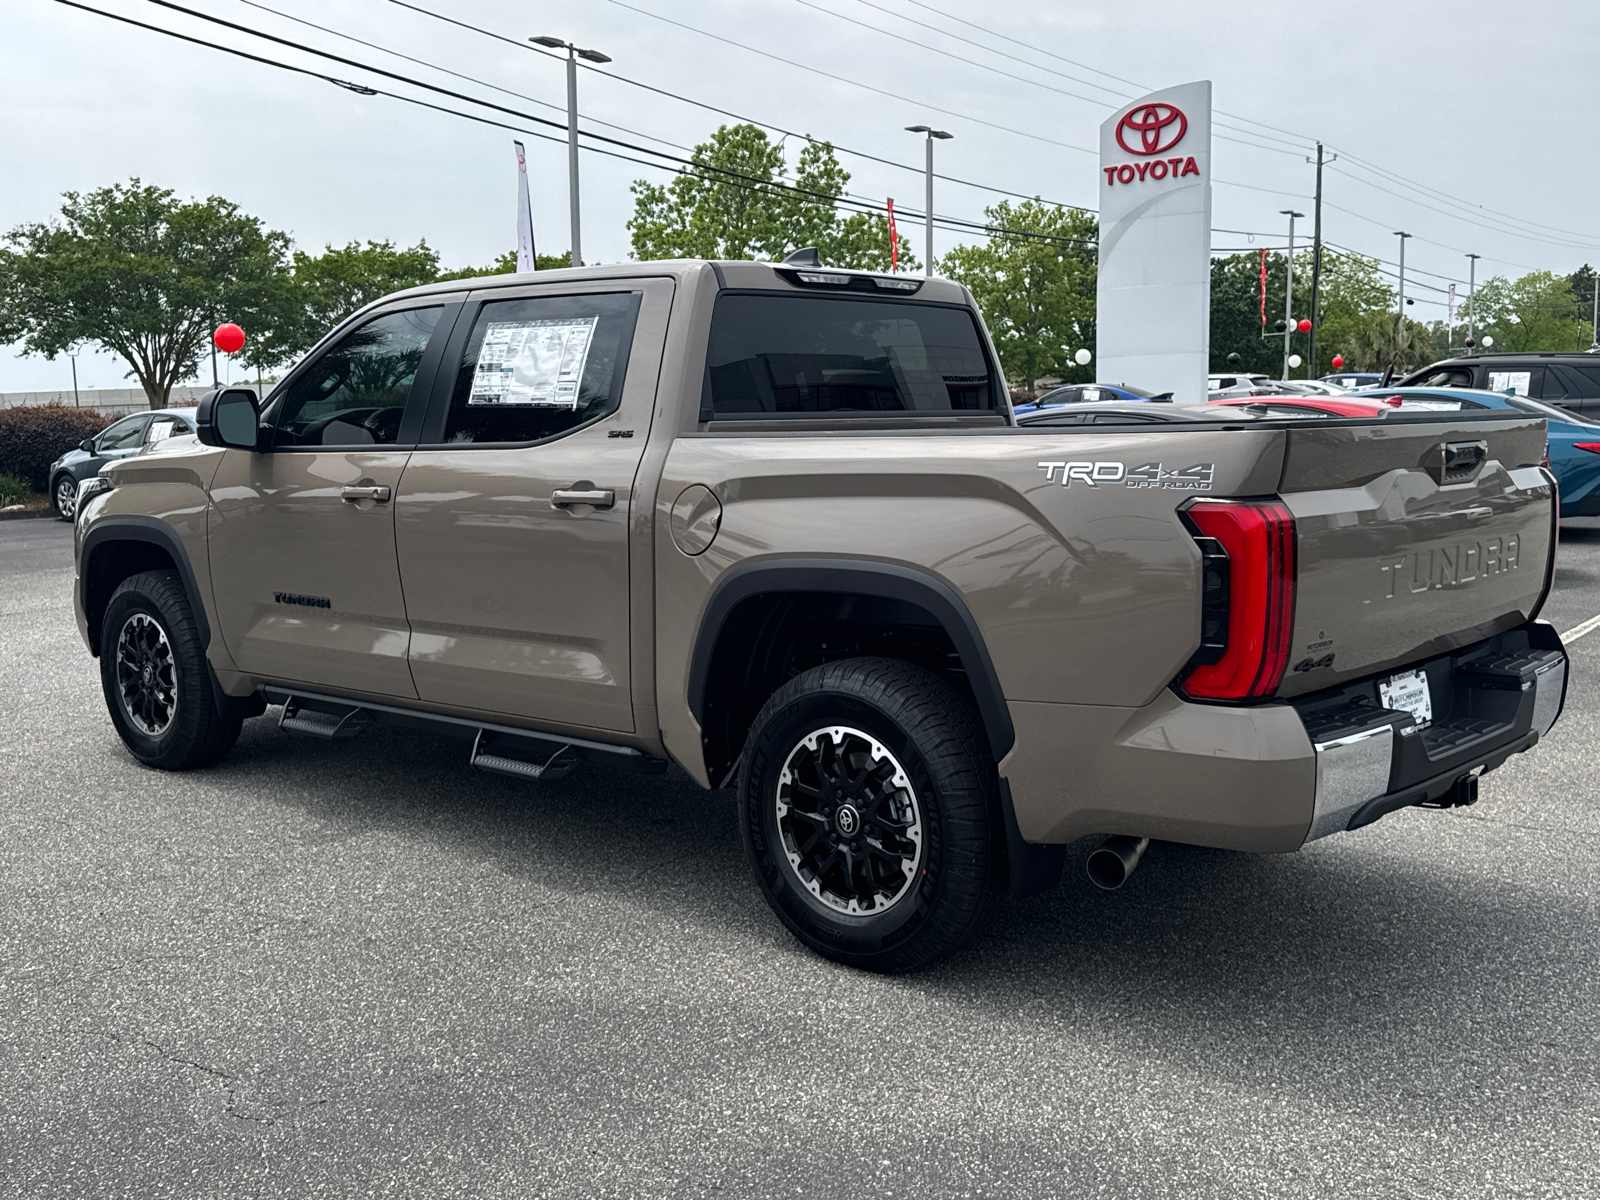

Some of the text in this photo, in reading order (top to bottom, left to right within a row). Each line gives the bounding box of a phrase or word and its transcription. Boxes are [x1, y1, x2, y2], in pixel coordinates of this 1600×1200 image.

[1103, 156, 1199, 186] TOYOTA
[1037, 461, 1215, 490] TRD 4x4
[1125, 480, 1212, 490] OFF ROAD
[1377, 533, 1521, 599] TUNDRA
[272, 591, 331, 609] TUNDRA
[748, 751, 767, 851] MICHELIN
[923, 791, 942, 899] MICHELIN
